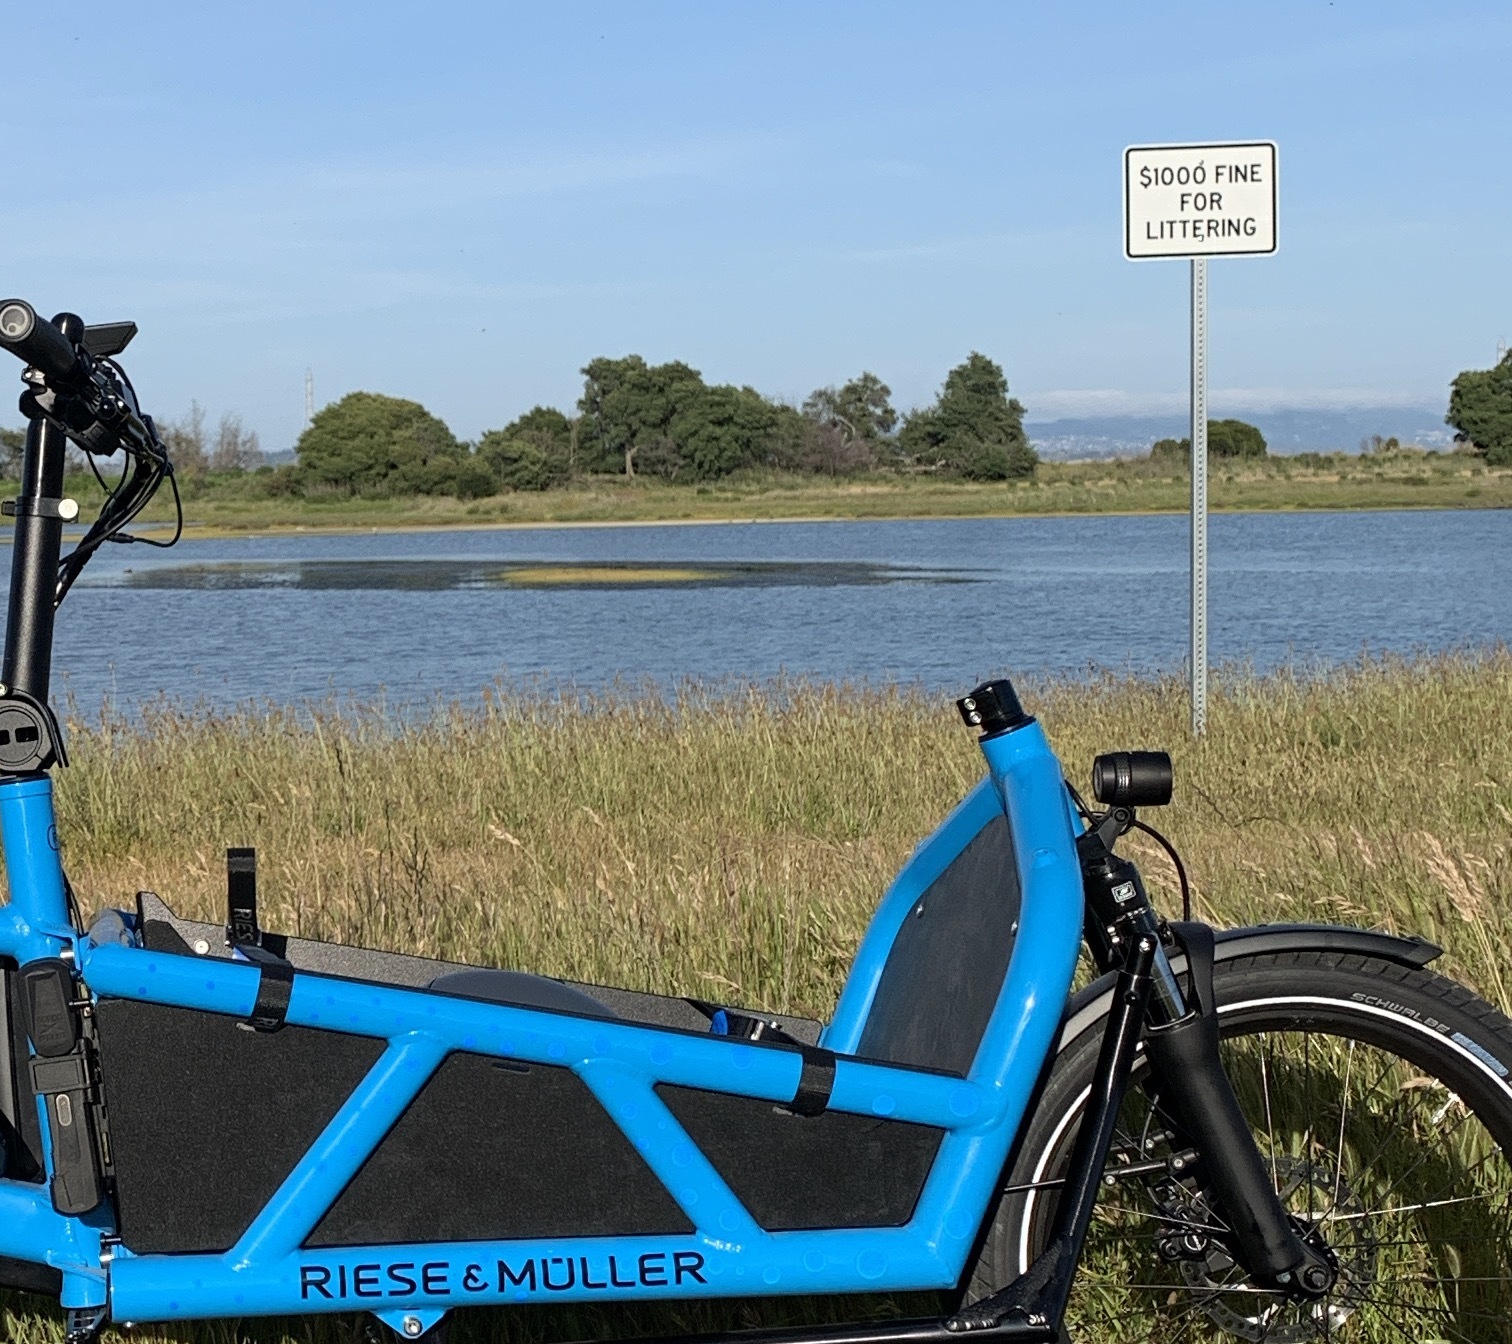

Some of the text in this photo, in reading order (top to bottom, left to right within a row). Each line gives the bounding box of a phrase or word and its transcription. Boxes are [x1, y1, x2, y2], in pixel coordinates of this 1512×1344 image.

[1139, 164, 1262, 189] $1000 FINE
[1180, 192, 1223, 211] FOR
[1146, 217, 1257, 240] LITTERING
[233, 908, 254, 940] RIES
[1350, 992, 1451, 1034] SCHWALBE
[300, 1251, 708, 1300] RIESE & MÜLLER
